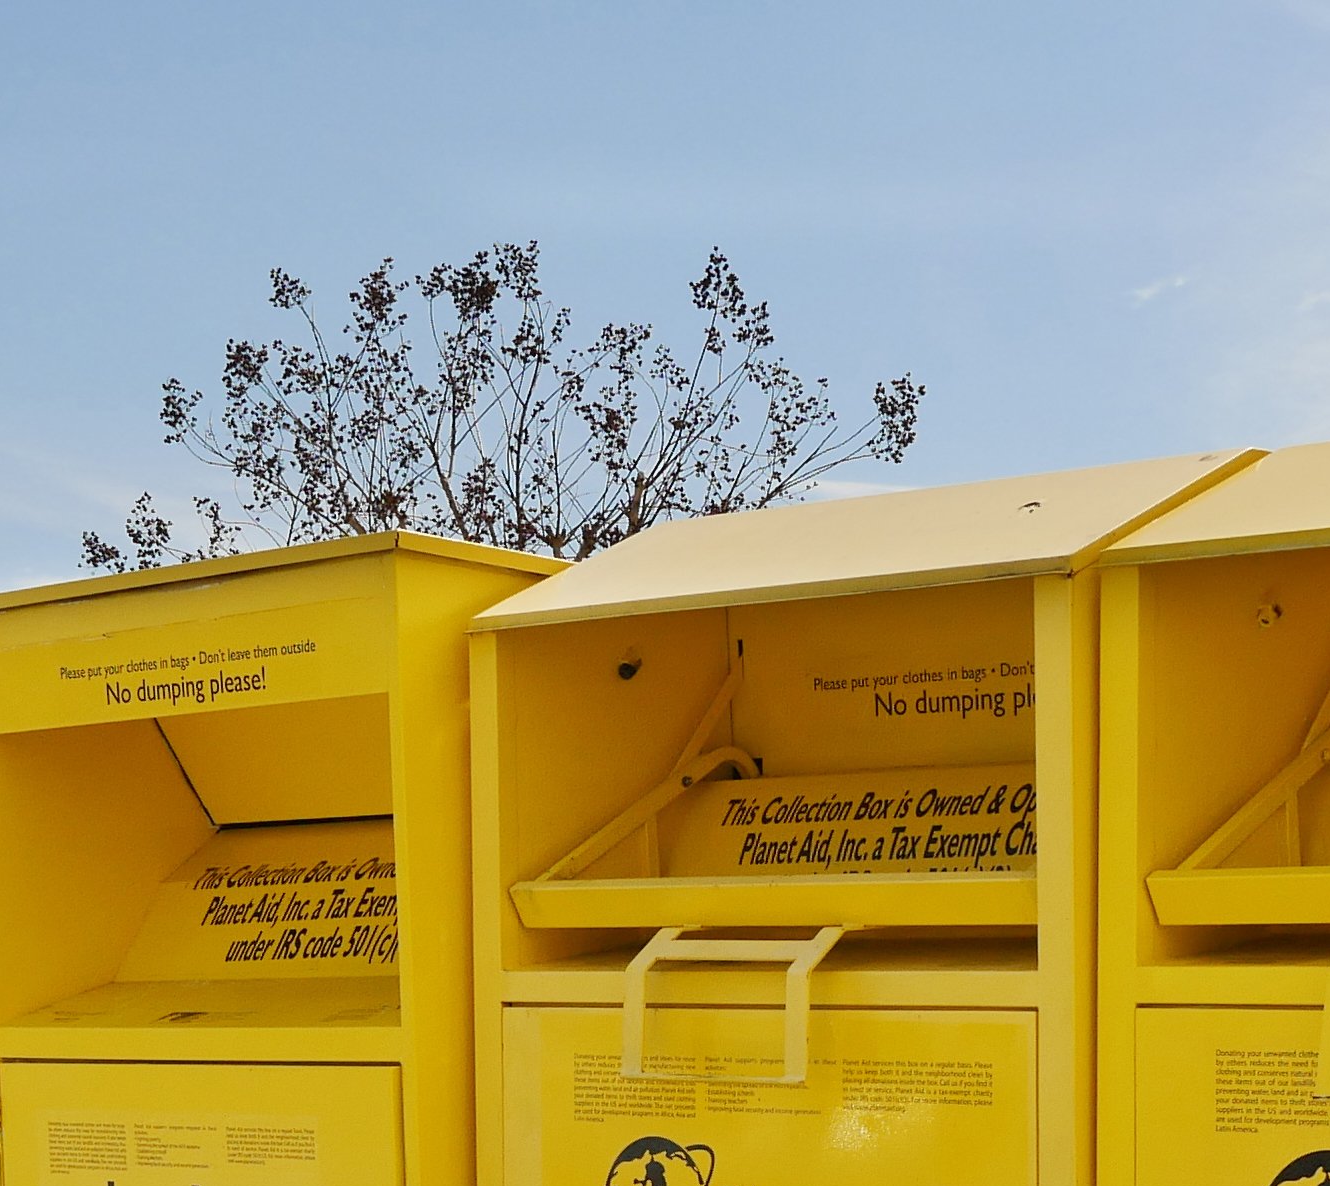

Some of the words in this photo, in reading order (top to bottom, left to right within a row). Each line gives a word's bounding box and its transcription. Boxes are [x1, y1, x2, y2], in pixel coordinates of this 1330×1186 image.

[60, 667, 86, 679] Please
[87, 666, 102, 680] put
[104, 664, 124, 679] your
[126, 659, 157, 673] clothes
[160, 659, 168, 669] in
[170, 655, 189, 671] bags
[199, 651, 225, 665] Don't
[227, 648, 251, 661] leave
[253, 645, 278, 659] them
[281, 639, 316, 655] outside
[814, 678, 847, 691] Please
[851, 677, 870, 692] put
[872, 675, 898, 691] your
[902, 669, 943, 684] clothes
[947, 668, 957, 680] in
[961, 666, 986, 683] bags
[1000, 661, 1035, 677] Don't
[106, 682, 131, 705] No
[137, 676, 205, 706] dumping
[210, 666, 266, 702] please!
[875, 692, 907, 717] No
[915, 688, 1005, 719] dumping
[721, 797, 759, 826] This
[761, 786, 853, 825] Collection
[853, 791, 889, 821] Box
[893, 790, 913, 818] is
[915, 786, 991, 817] Owned
[987, 783, 1008, 815] &
[739, 832, 798, 866] Planet
[796, 829, 834, 871] Aid,
[835, 829, 868, 862] Inc.
[871, 838, 883, 861] a
[887, 826, 921, 862] Tax
[922, 825, 1001, 868] Exempt
